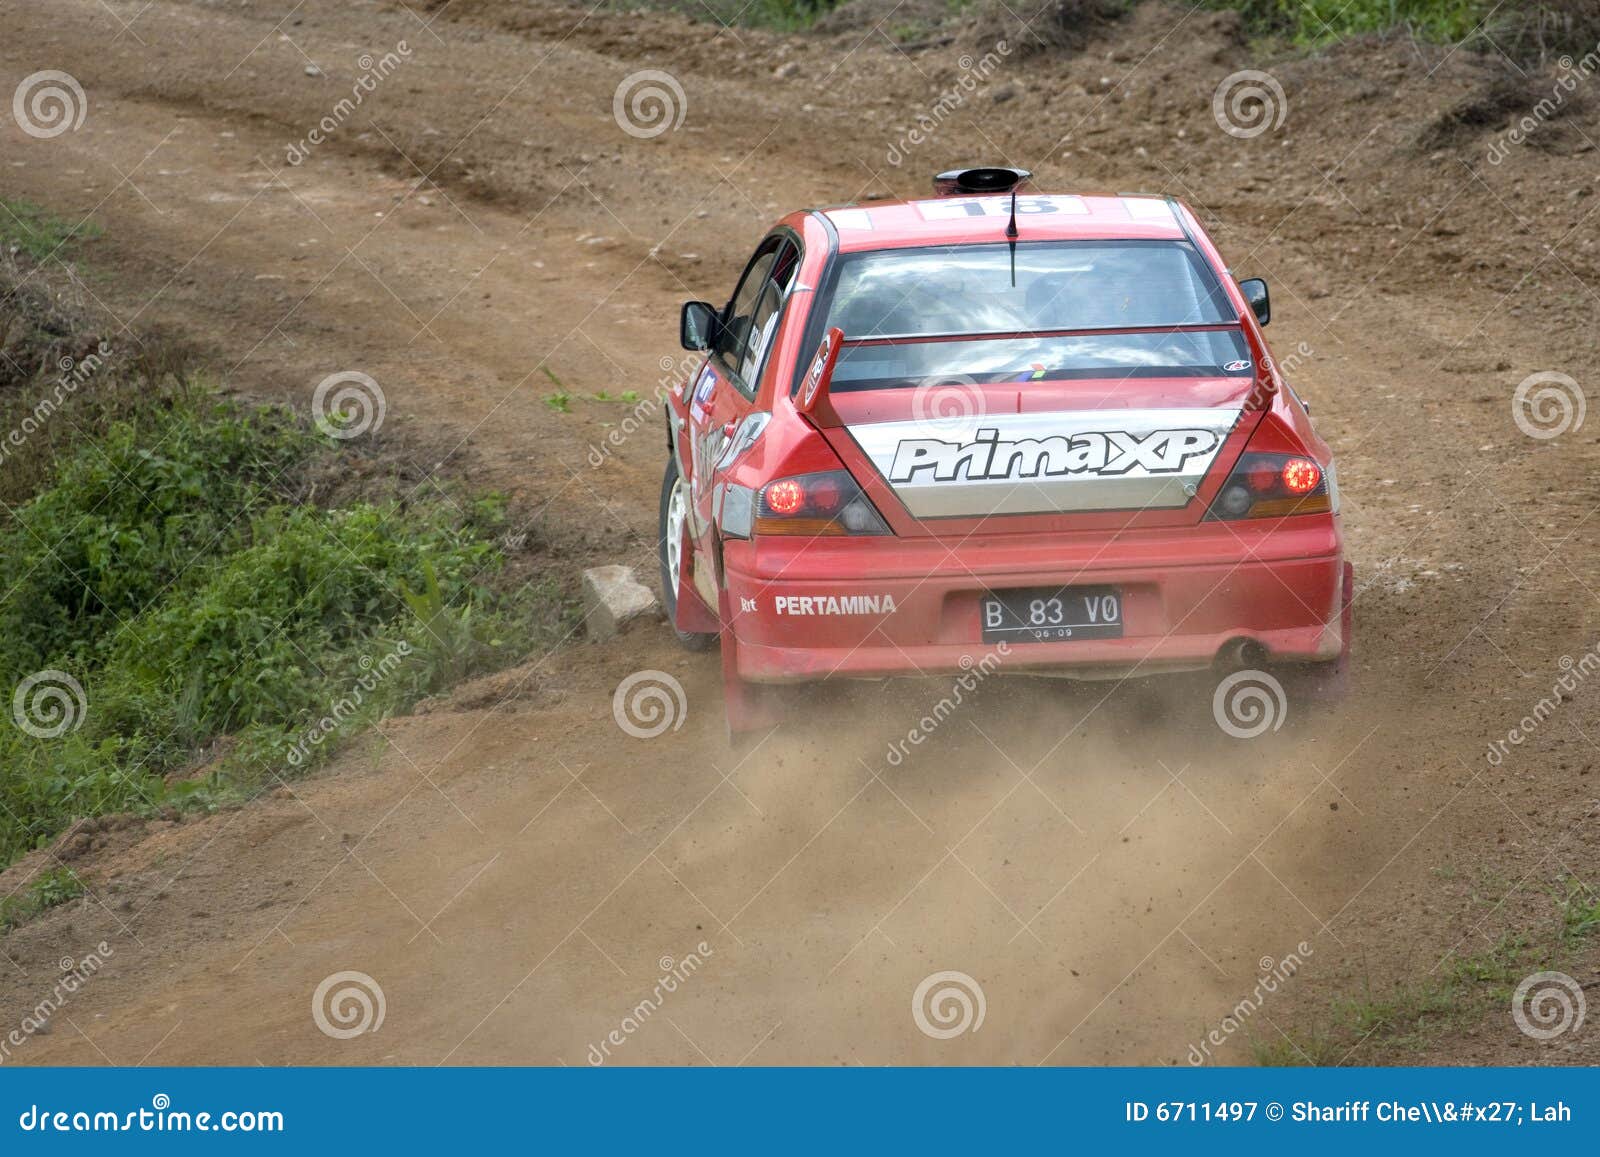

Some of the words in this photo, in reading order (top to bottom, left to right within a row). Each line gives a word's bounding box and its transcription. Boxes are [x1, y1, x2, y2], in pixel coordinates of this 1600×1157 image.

[775, 594, 896, 615] PERTAMINA
[985, 601, 1003, 627] B
[1029, 598, 1063, 625] 83
